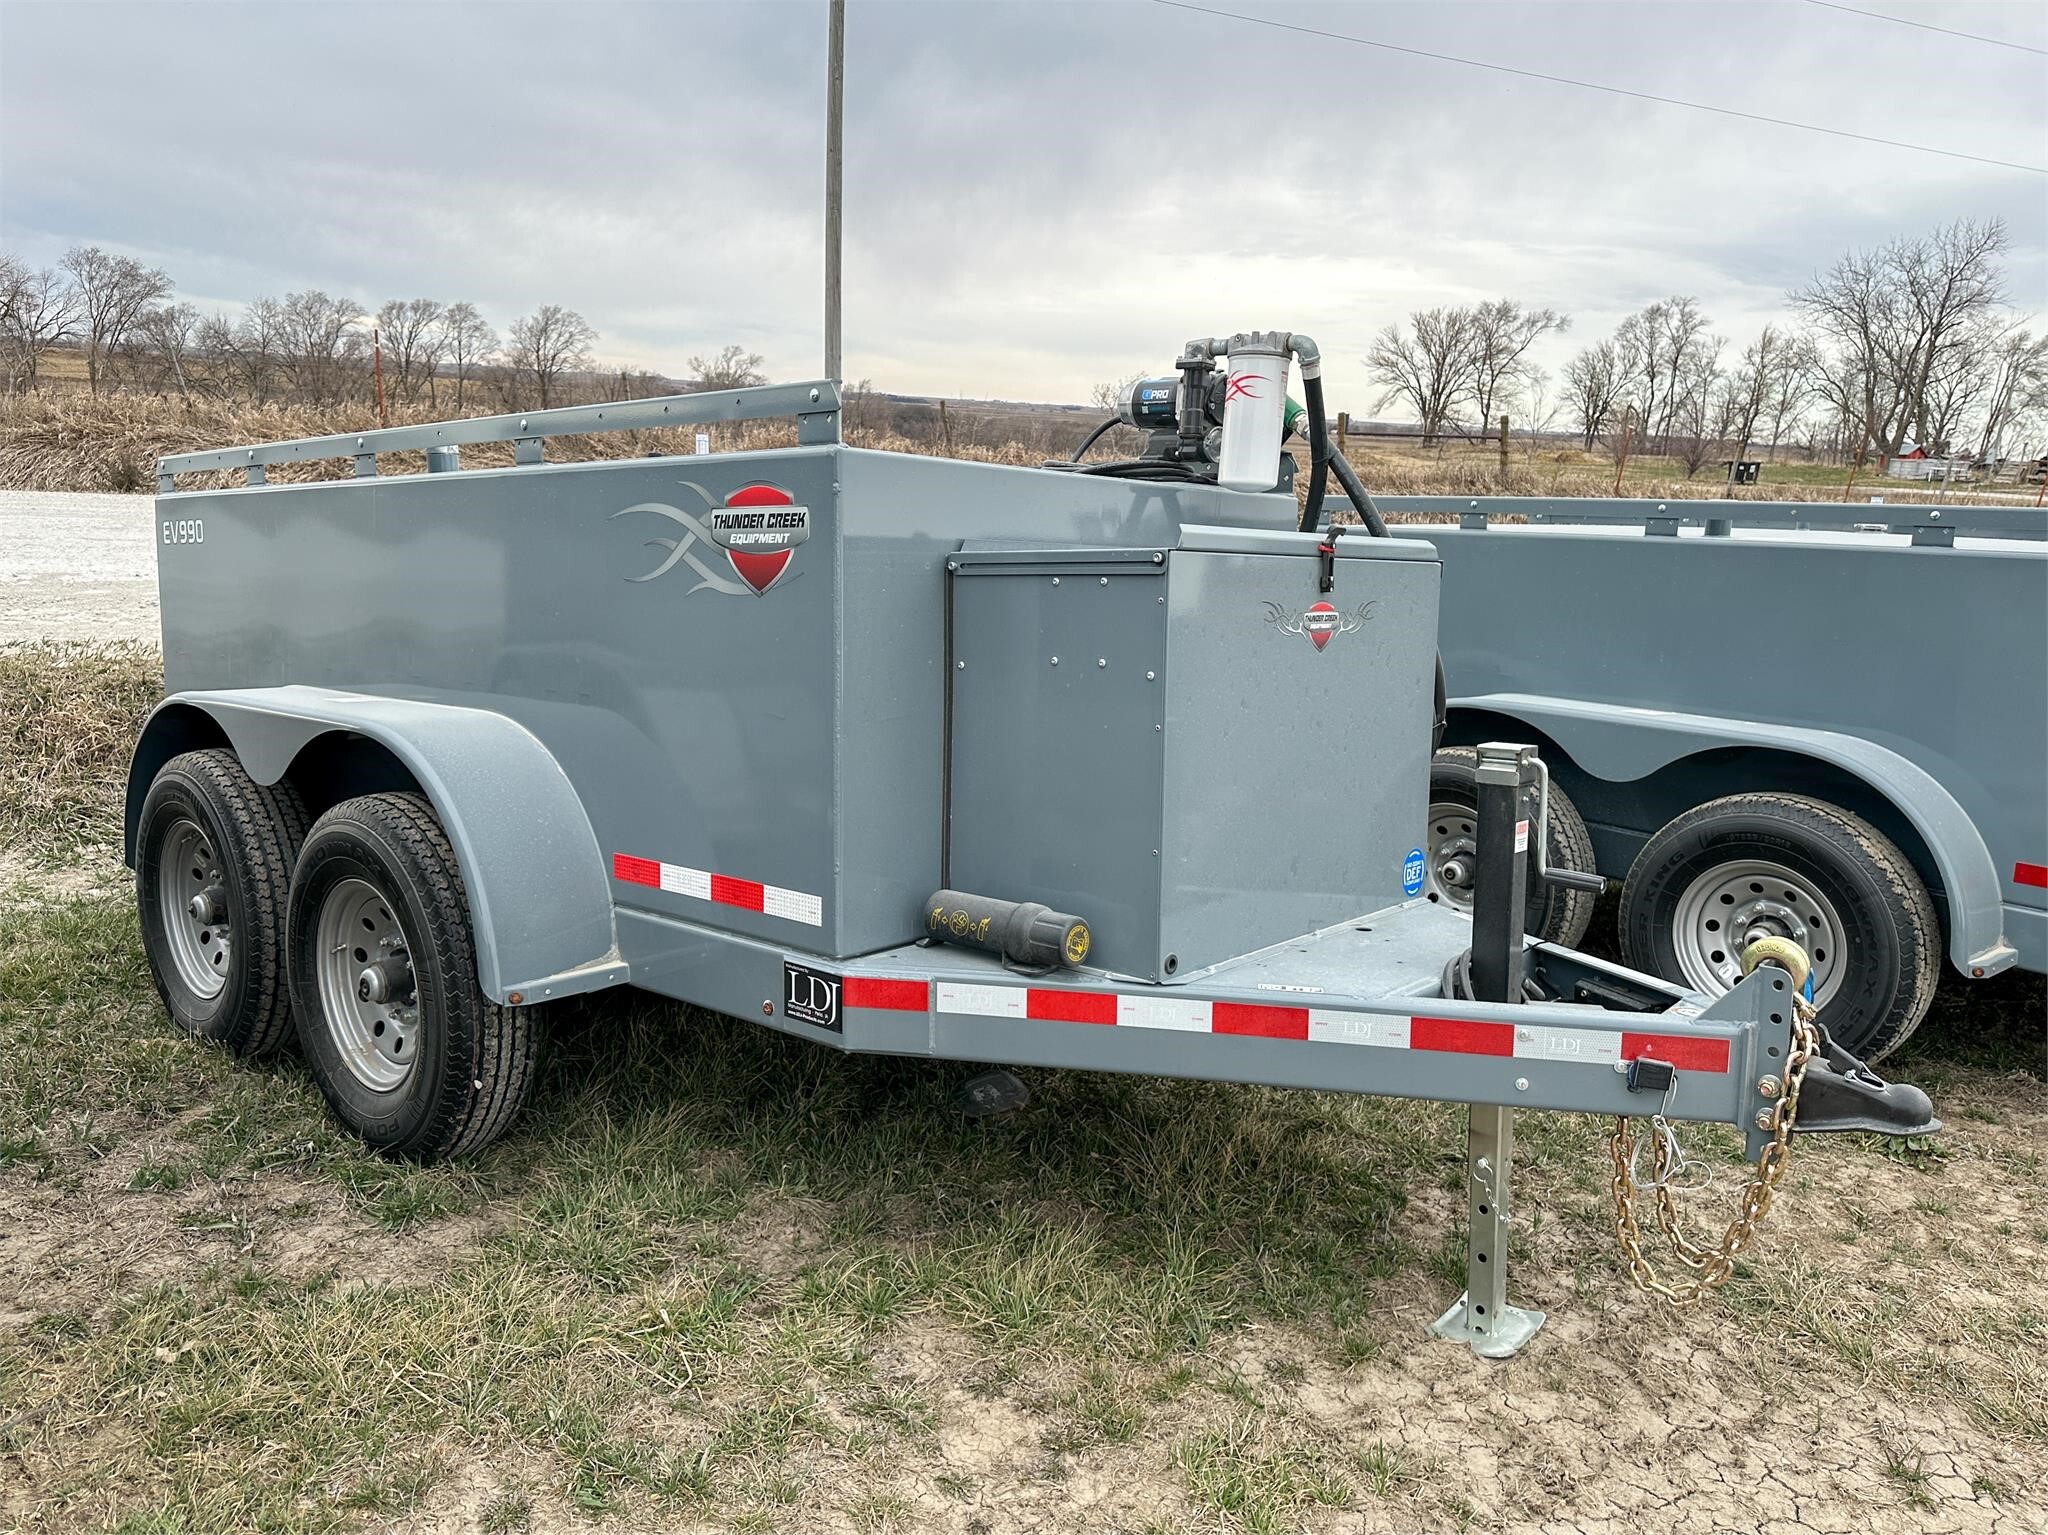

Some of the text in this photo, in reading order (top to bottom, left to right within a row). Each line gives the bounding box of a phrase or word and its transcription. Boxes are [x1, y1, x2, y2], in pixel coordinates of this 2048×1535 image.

[713, 512, 807, 529] THUNDER CREEK
[163, 520, 204, 544] EV990
[730, 533, 791, 544] EQUIPMENT
[1406, 866, 1421, 881] DEF
[787, 970, 841, 1025] LDJ
[1343, 1021, 1373, 1039] LDJ
[1551, 1037, 1582, 1054] LDJ
